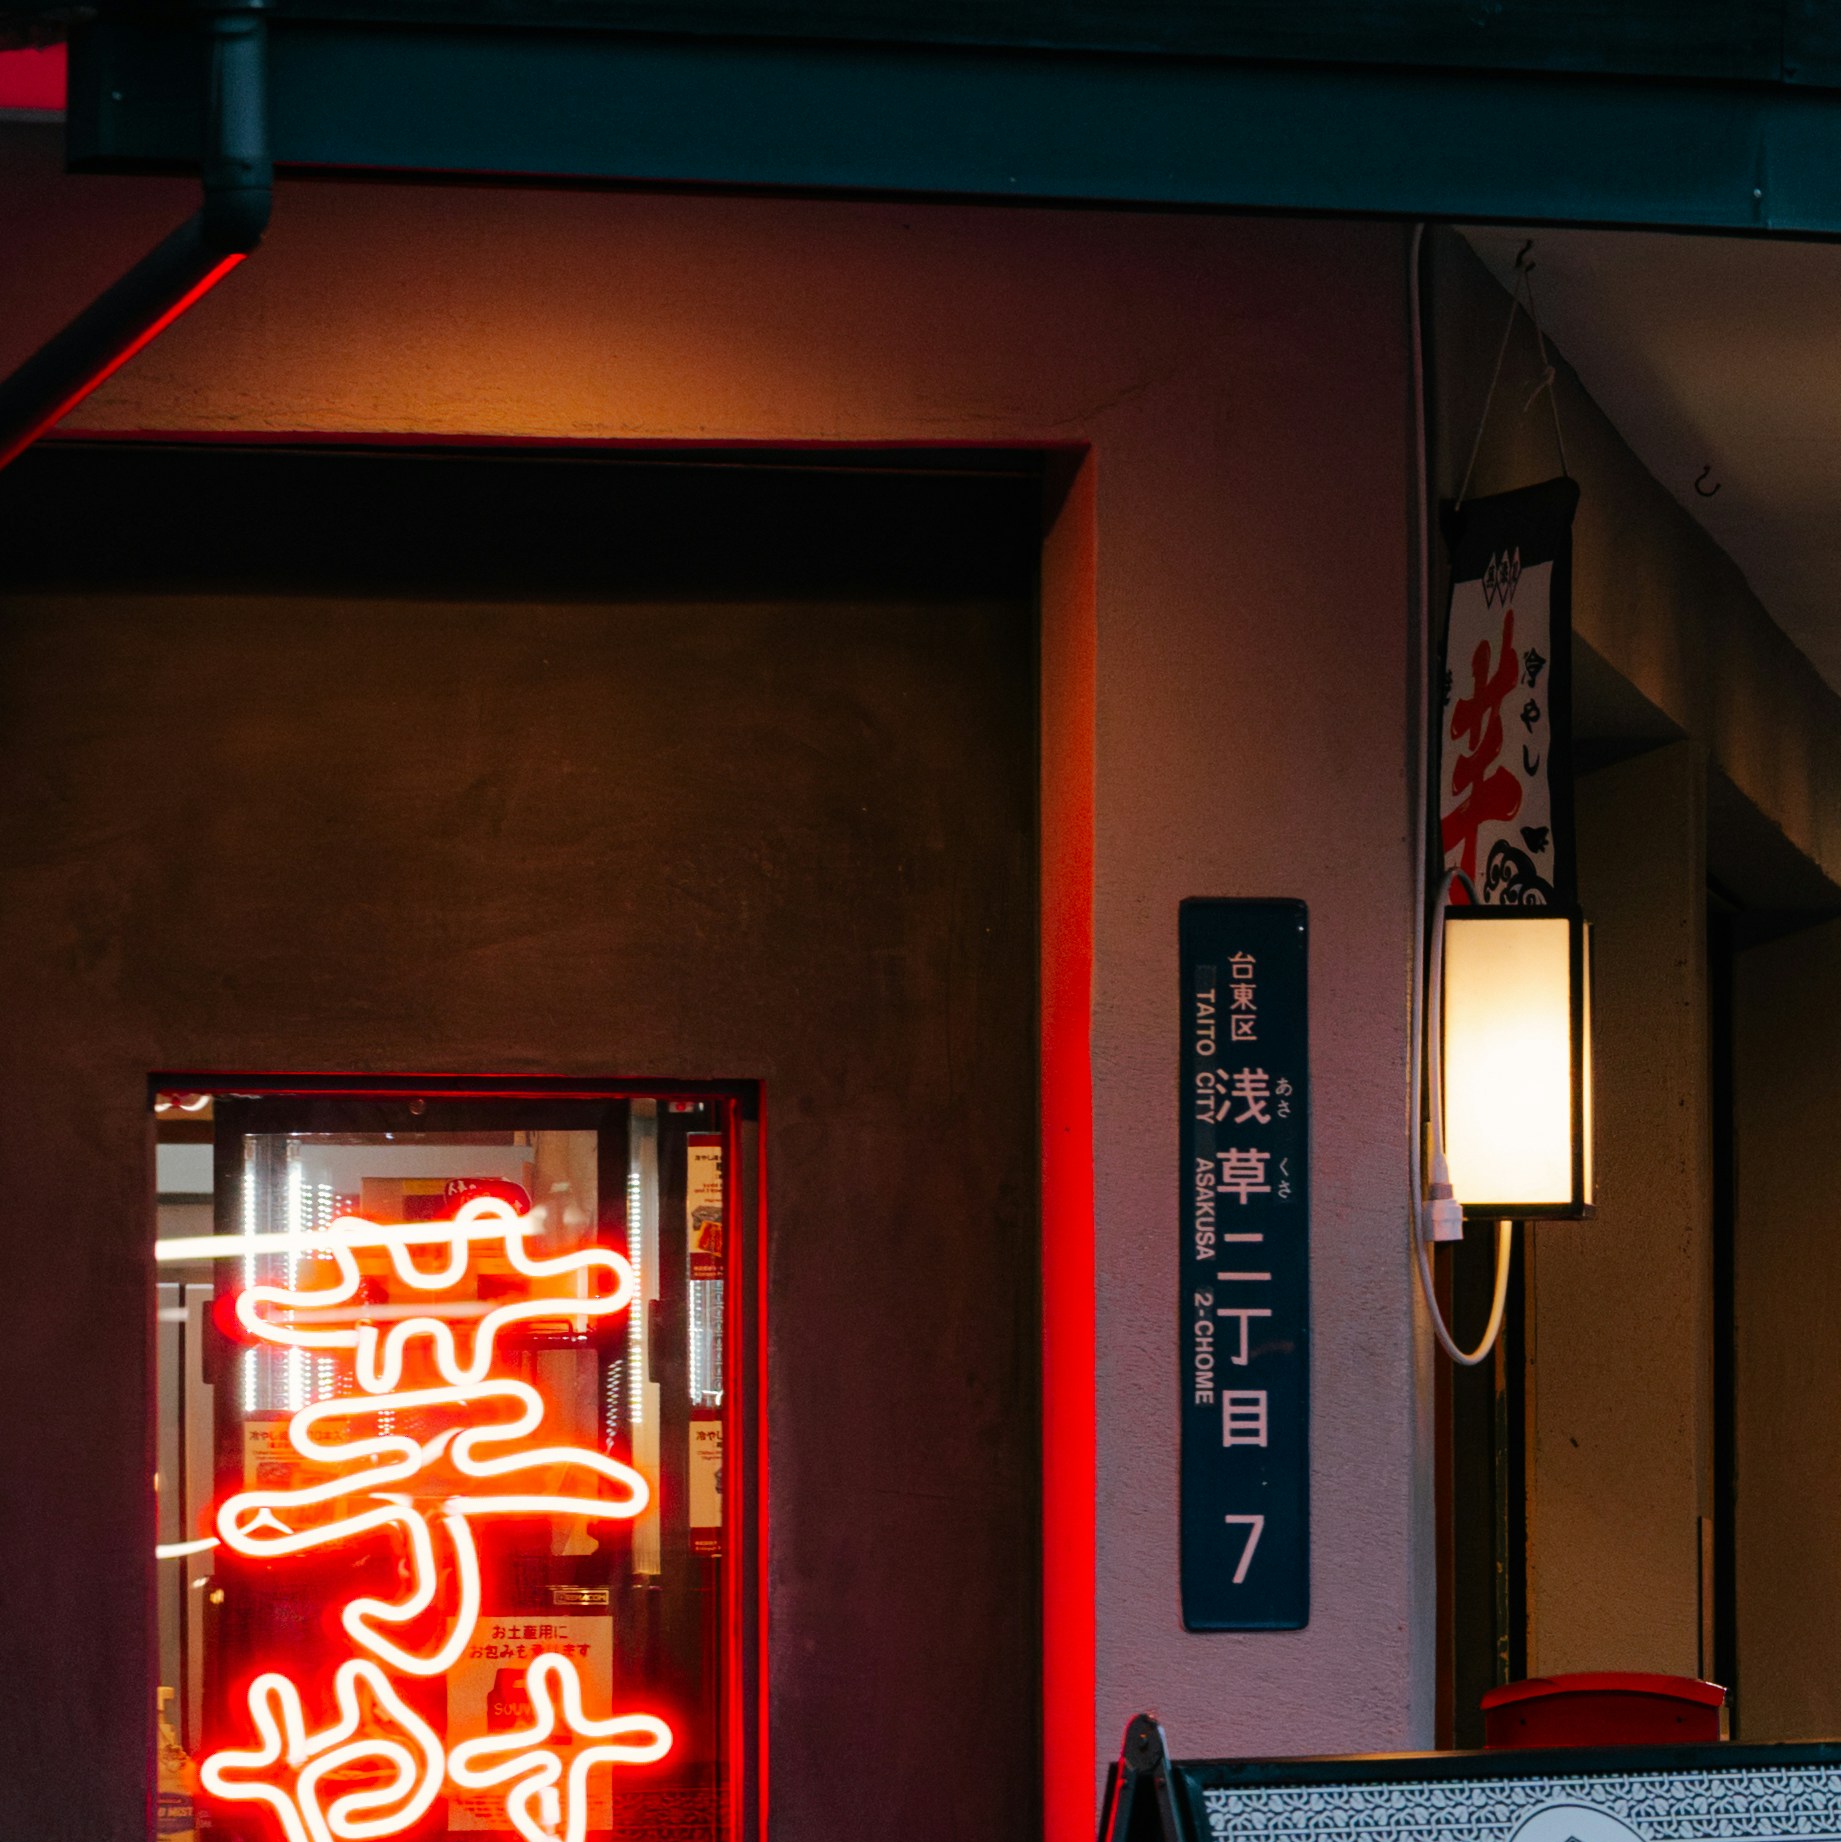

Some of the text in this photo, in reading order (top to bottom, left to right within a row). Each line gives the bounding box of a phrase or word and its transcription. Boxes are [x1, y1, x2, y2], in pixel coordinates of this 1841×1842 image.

[1193, 988, 1216, 1405] TAITO CITY ASAKUSA 2-CHOME
[1215, 950, 1272, 1585] 台東区 浅草二丁目 7
[491, 1624, 569, 1640] お土産用に
